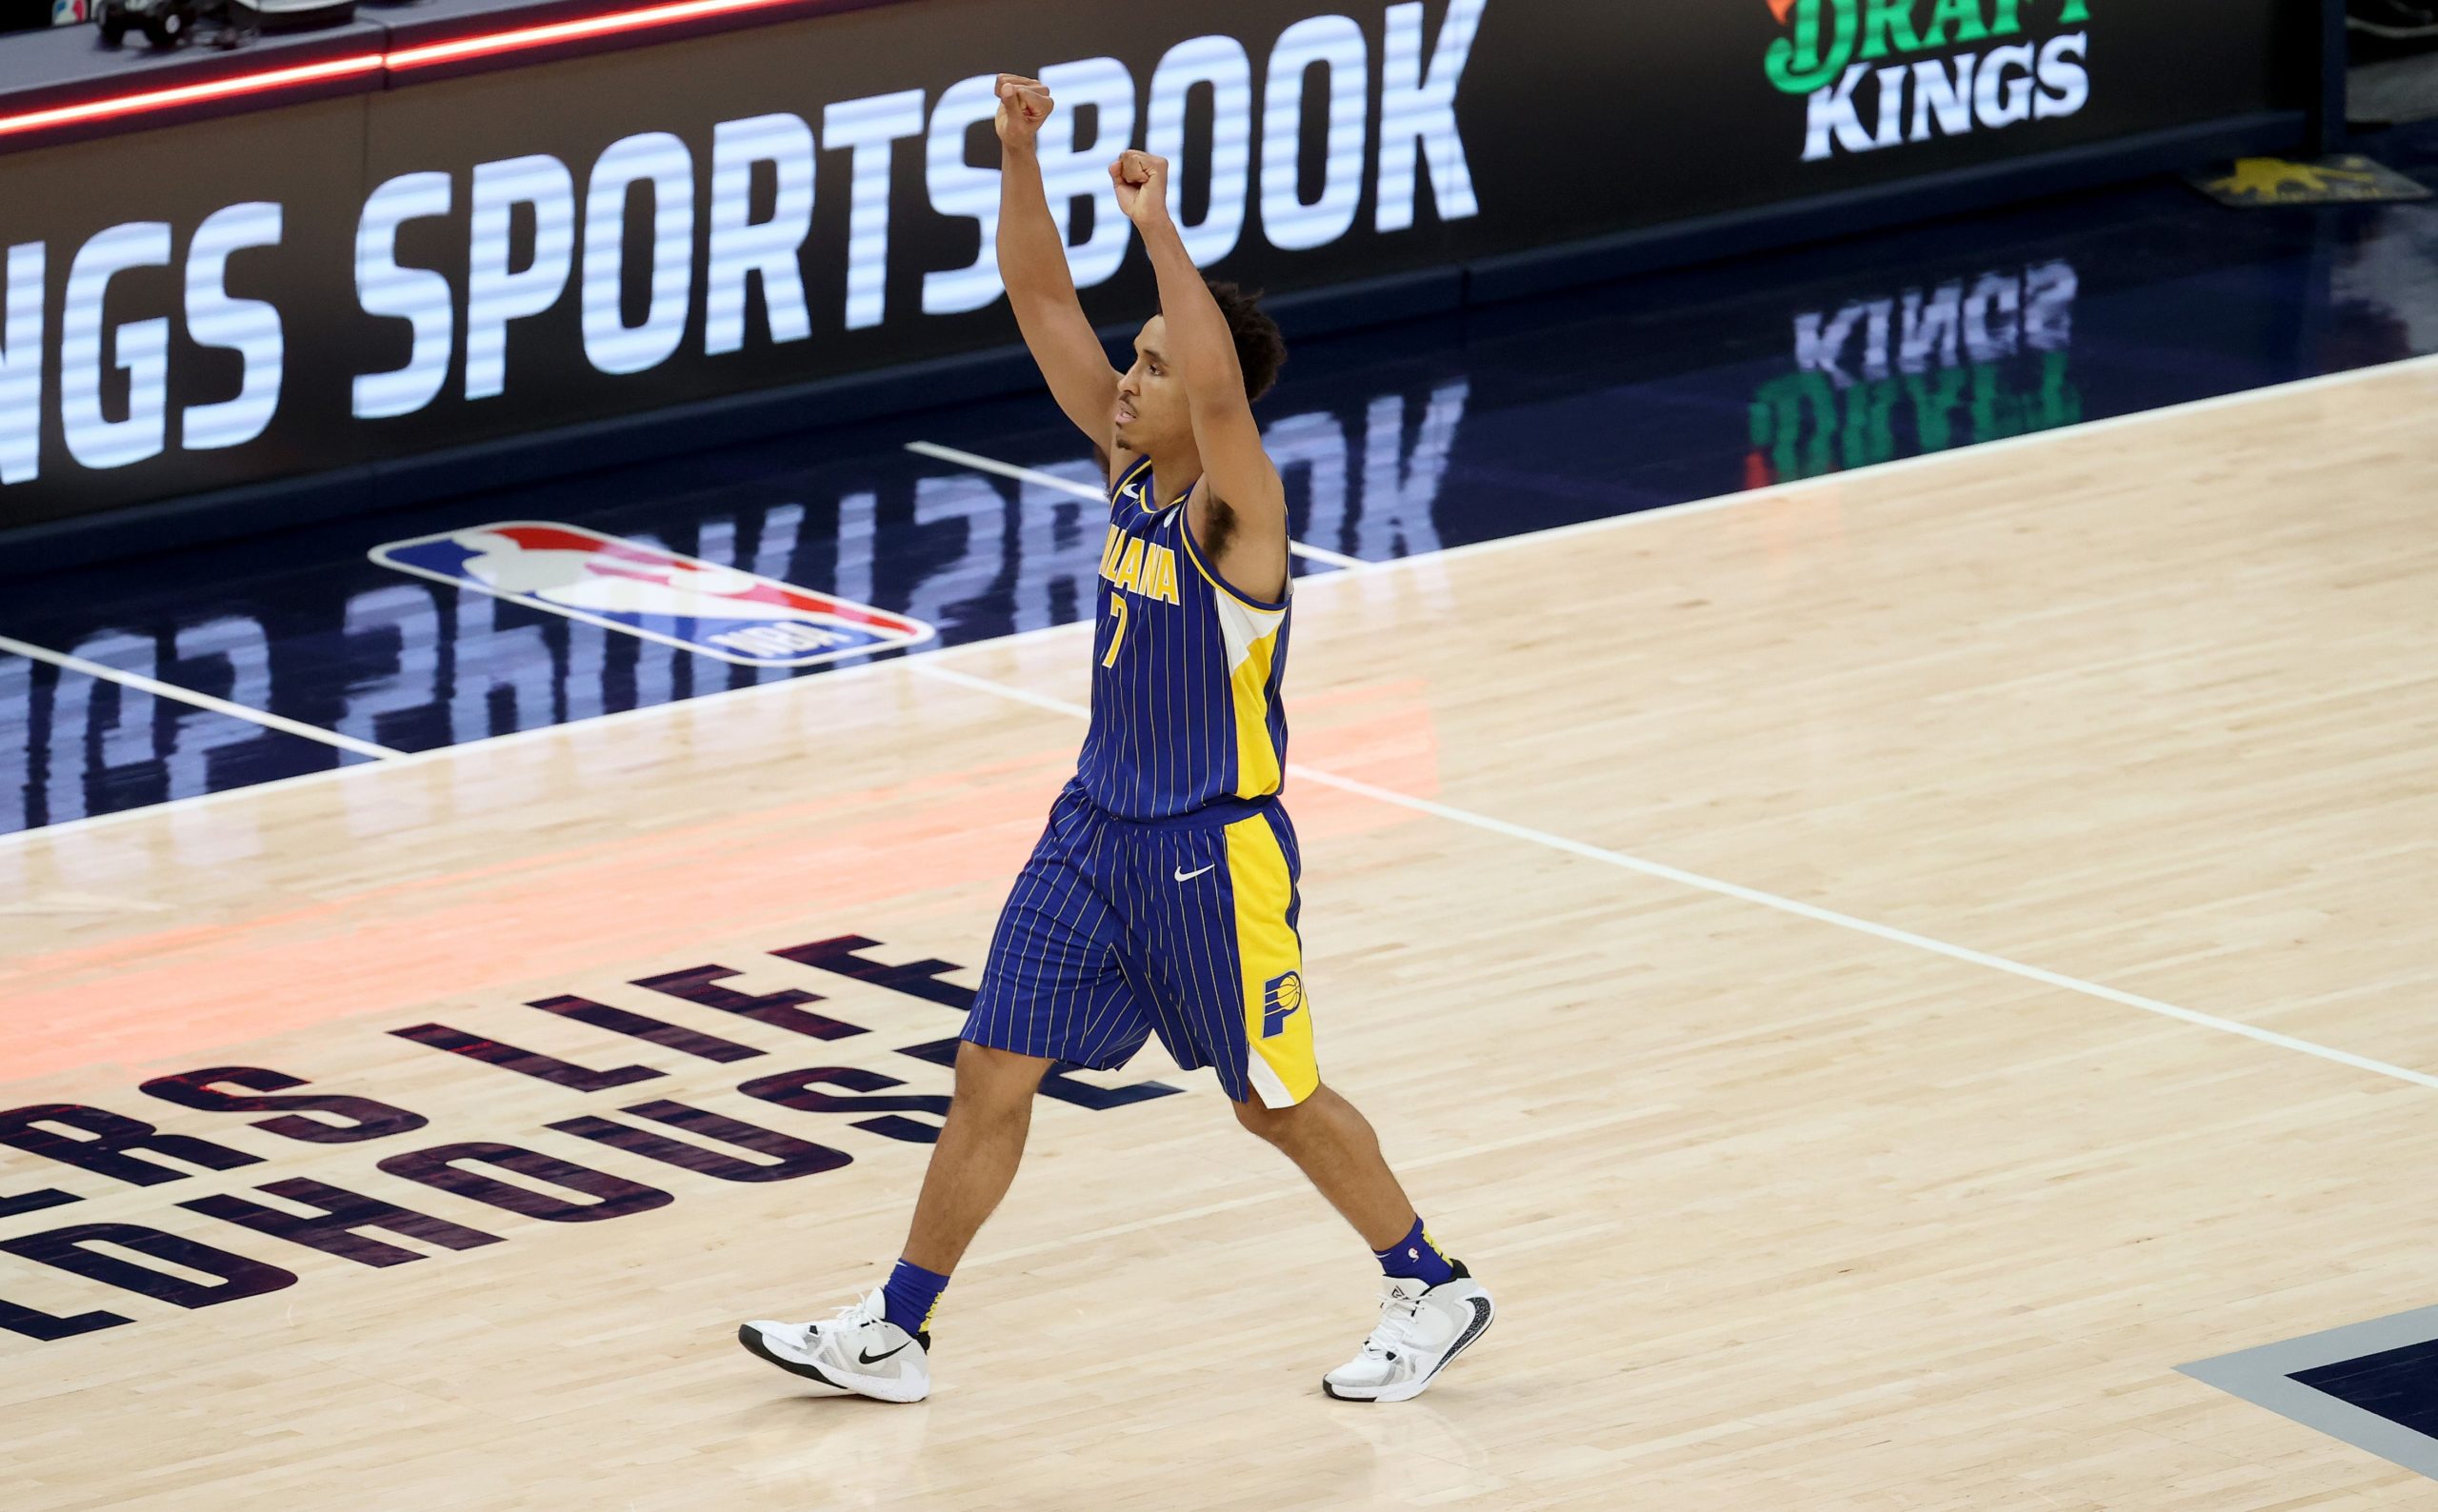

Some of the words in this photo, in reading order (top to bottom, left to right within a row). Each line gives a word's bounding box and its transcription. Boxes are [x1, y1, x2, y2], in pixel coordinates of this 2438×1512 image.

[1764, 0, 2090, 93] DRA
[1799, 30, 2088, 162] KINGS
[351, 0, 1486, 420] SPORTSBOOK
[1102, 591, 1128, 668] 7
[386, 933, 975, 1093] LIFE
